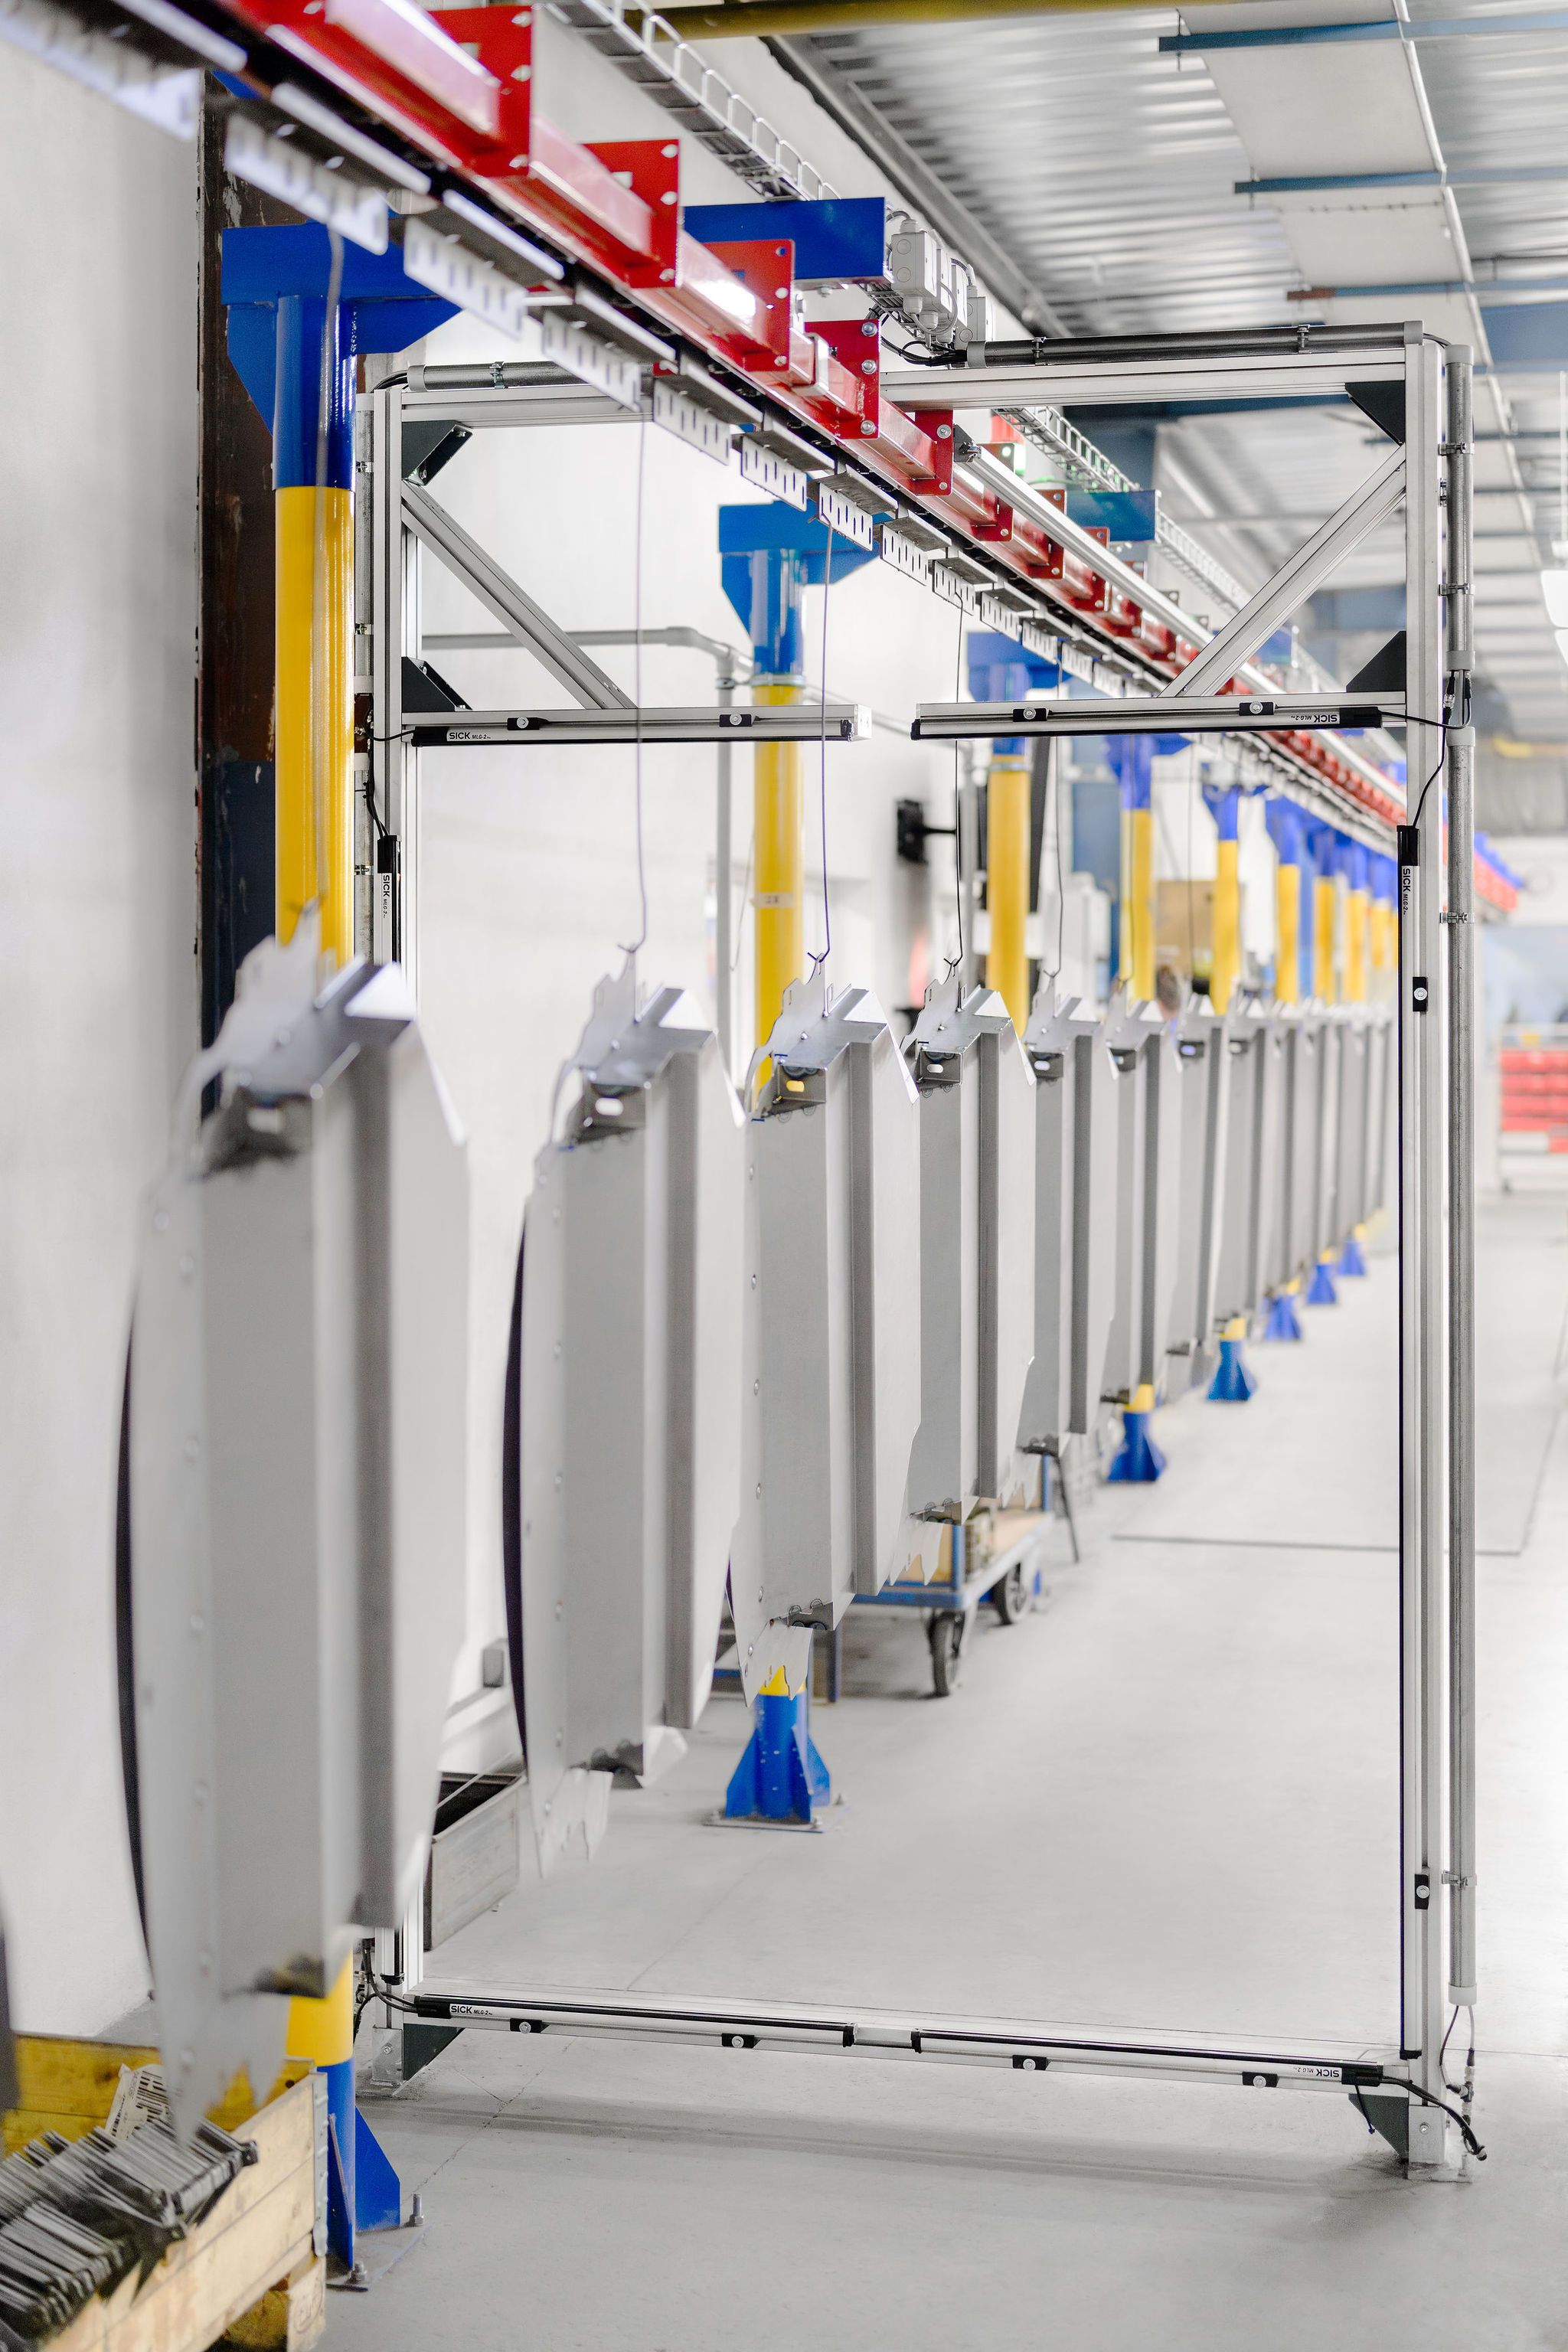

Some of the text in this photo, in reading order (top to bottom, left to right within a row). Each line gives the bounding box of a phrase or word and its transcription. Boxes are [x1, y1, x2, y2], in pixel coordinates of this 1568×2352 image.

[1313, 714, 1338, 723] SICK
[1403, 867, 1411, 893] SICK
[450, 2005, 472, 2014] SICK
[1315, 2068, 1340, 2077] SICK
